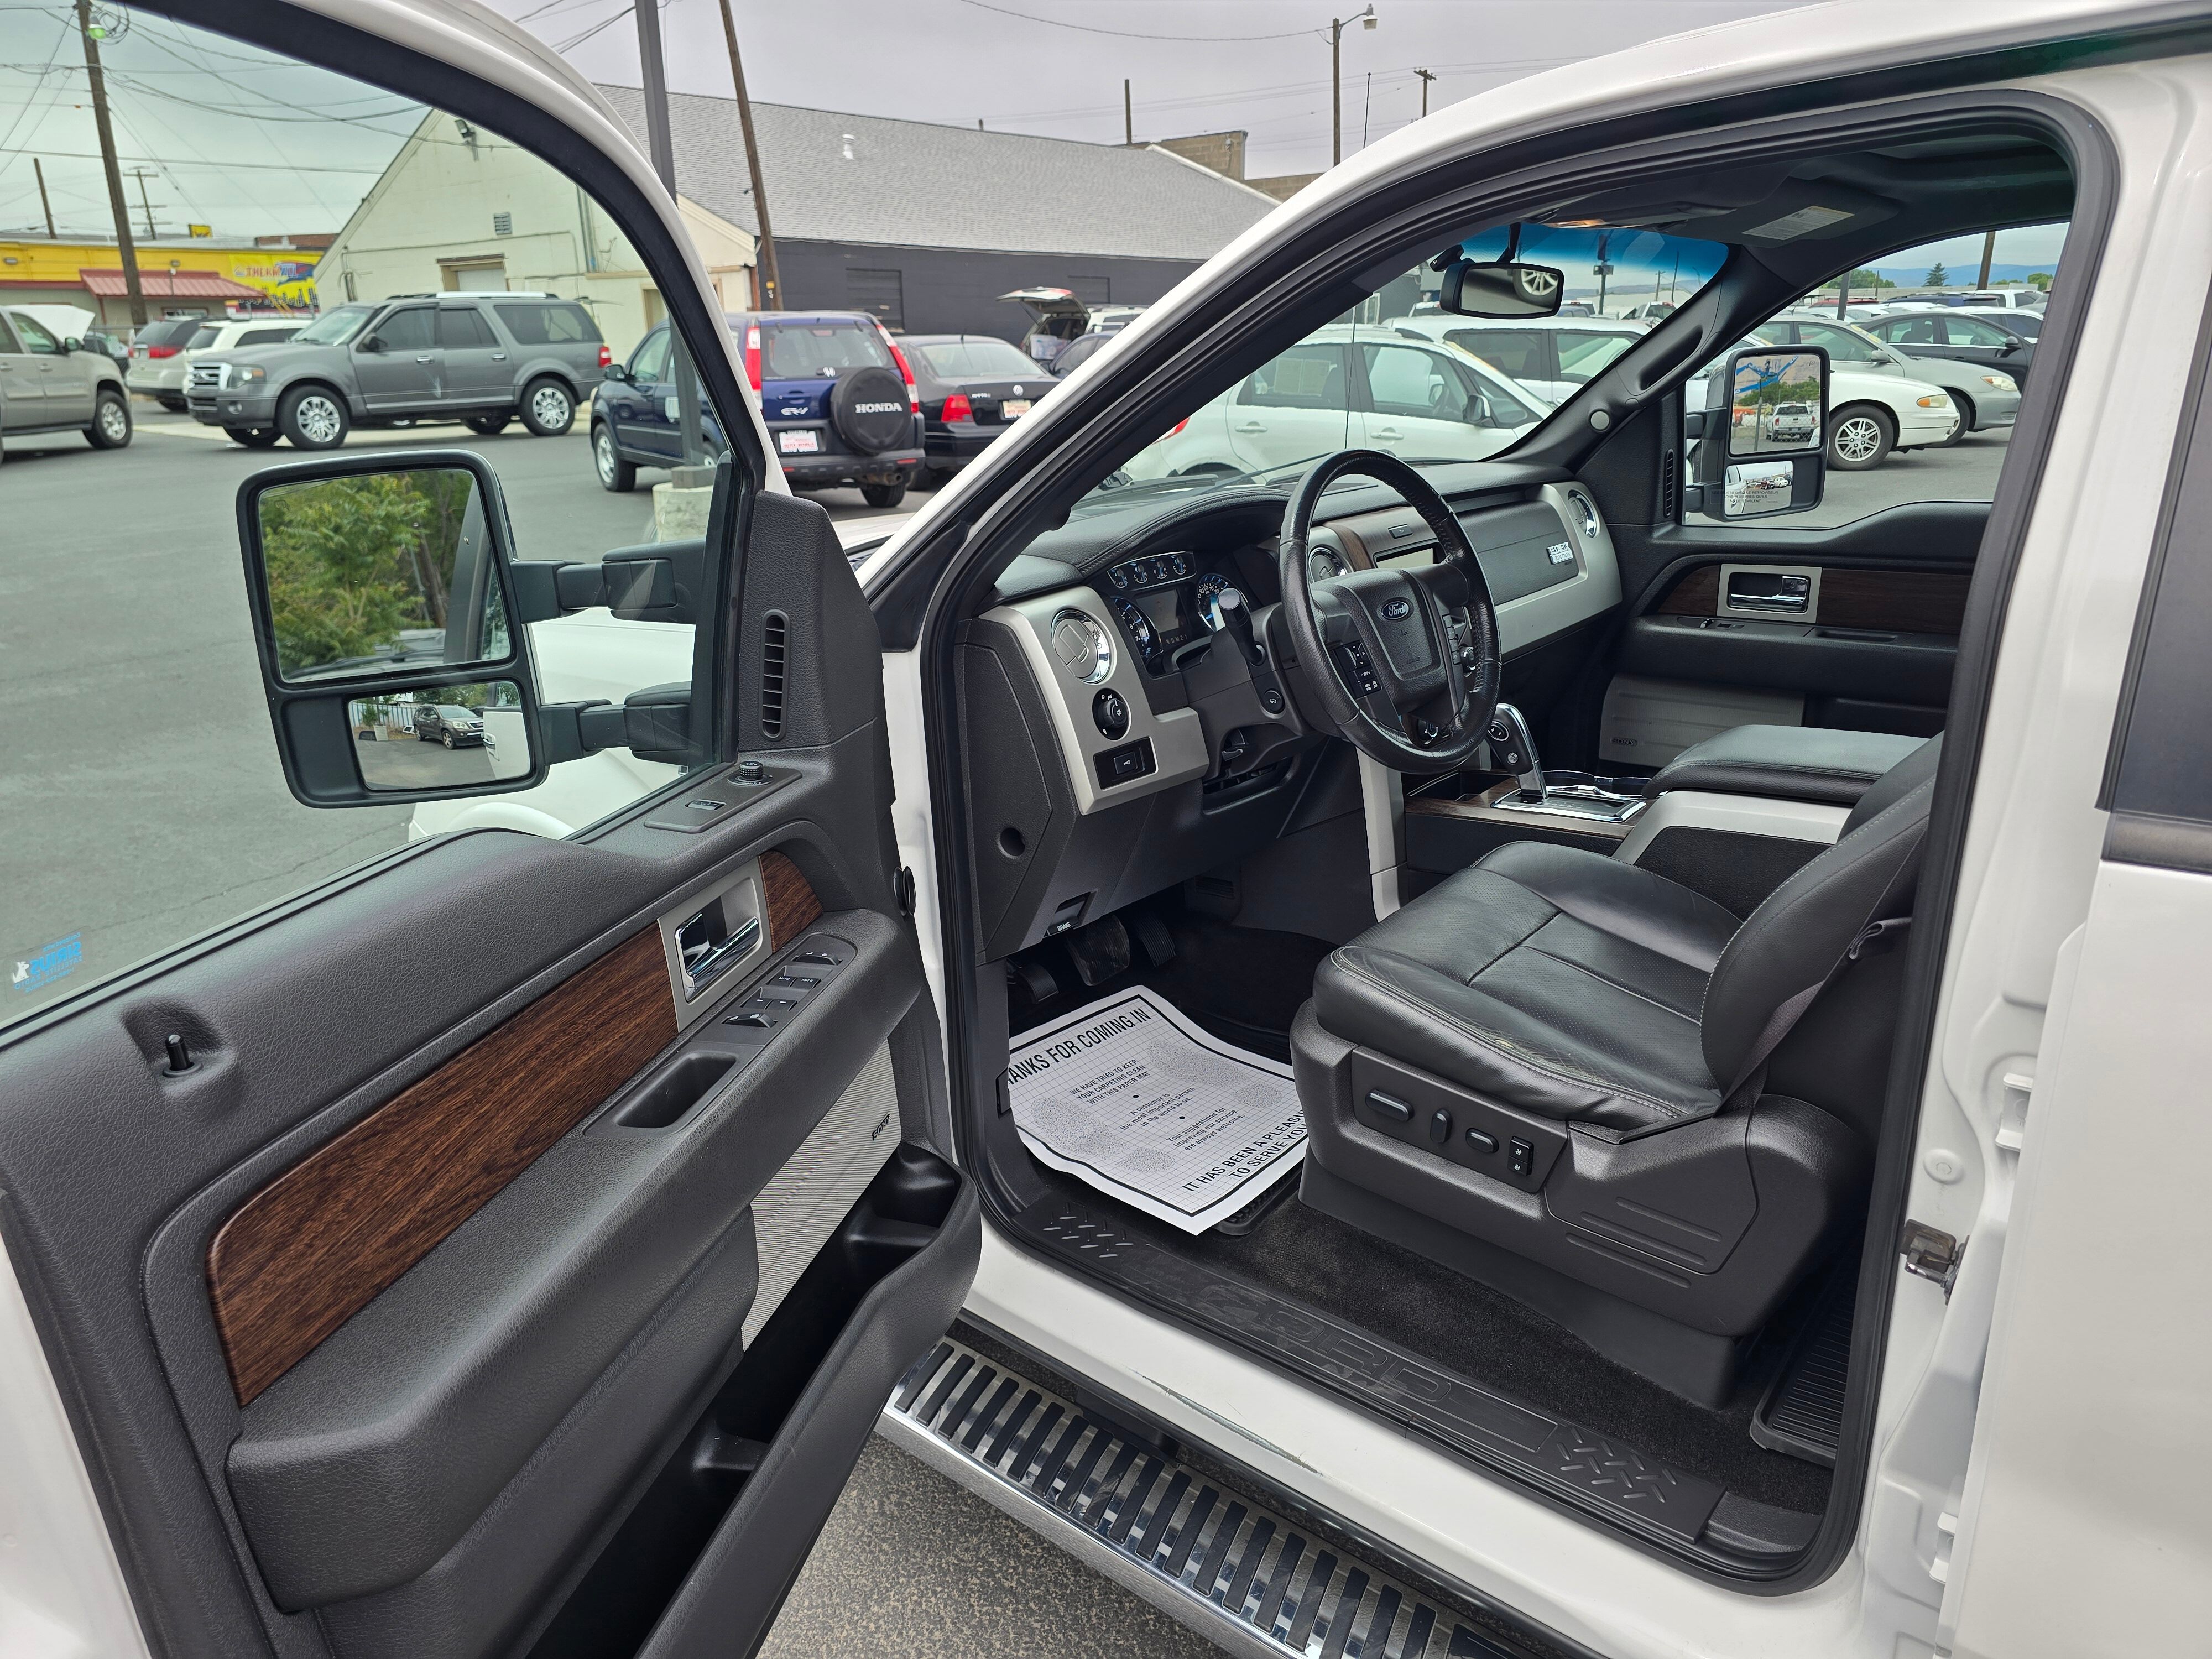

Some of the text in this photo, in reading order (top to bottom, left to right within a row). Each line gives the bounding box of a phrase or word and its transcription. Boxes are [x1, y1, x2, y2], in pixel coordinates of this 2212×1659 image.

[855, 402, 902, 414] HONDA
[1388, 603, 1405, 617] Ford
[1611, 737, 1636, 746] SONY
[1057, 921, 1071, 931] BRAKE
[1008, 1008, 1151, 1084] ANKS FOR COMING IN
[1077, 1065, 1146, 1100] YOUR CARPETING CLEAN
[1080, 1079, 1098, 1090] HAVE
[1095, 1071, 1115, 1082] TRIED
[1121, 1059, 1136, 1070] KEEP
[1087, 1071, 1150, 1104] WITH THIS PAPER MAT
[1131, 1113, 1149, 1124] most
[1147, 1098, 1176, 1114] important
[1175, 1087, 1196, 1099] person
[1136, 1097, 1164, 1112] customer
[1159, 1105, 1176, 1117] world
[1166, 1133, 1183, 1142] Your
[1182, 1112, 1218, 1134] suggestions
[1173, 1129, 1207, 1147] improving
[1214, 1110, 1237, 1124] service
[1195, 1131, 1218, 1145] always
[1216, 1114, 1245, 1132] welcome.
[1182, 1182, 1199, 1192] IT
[1196, 1166, 1226, 1184] HAS
[1222, 1146, 1258, 1167] BEEN
[1262, 1109, 1304, 1140] PLEASU
[1228, 1167, 1251, 1178] TO
[1247, 1141, 1288, 1166] SERVE
